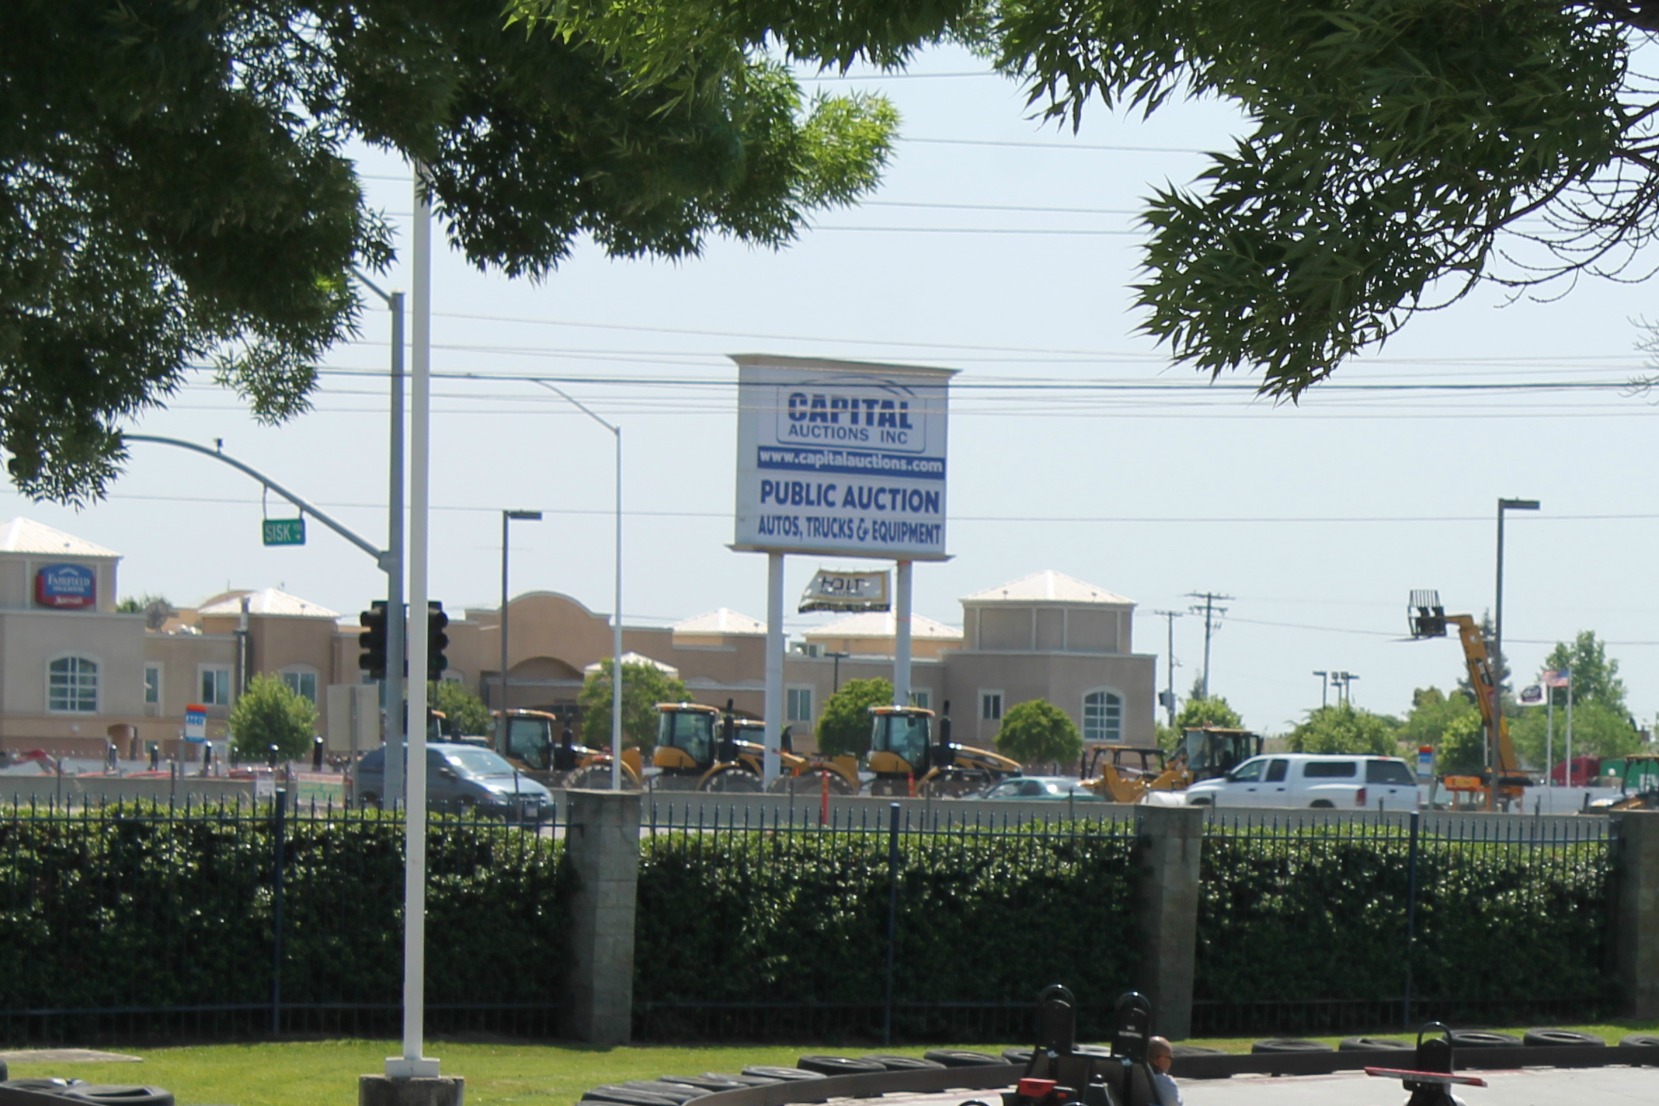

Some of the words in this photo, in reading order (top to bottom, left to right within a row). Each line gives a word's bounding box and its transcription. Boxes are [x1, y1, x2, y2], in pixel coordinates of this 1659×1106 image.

[788, 392, 913, 430] CAPITAL
[788, 424, 870, 443] AUCTIONS
[881, 430, 908, 445] INC
[759, 449, 944, 474] www.capitalauctions.com
[760, 479, 837, 508] PUBLIC
[842, 485, 940, 514] AUCTION
[265, 523, 292, 542] SISK
[758, 515, 804, 541] AUTOS,
[806, 516, 854, 541] TRUCKS
[856, 518, 870, 542] &
[872, 521, 942, 545] EQUIPMENT
